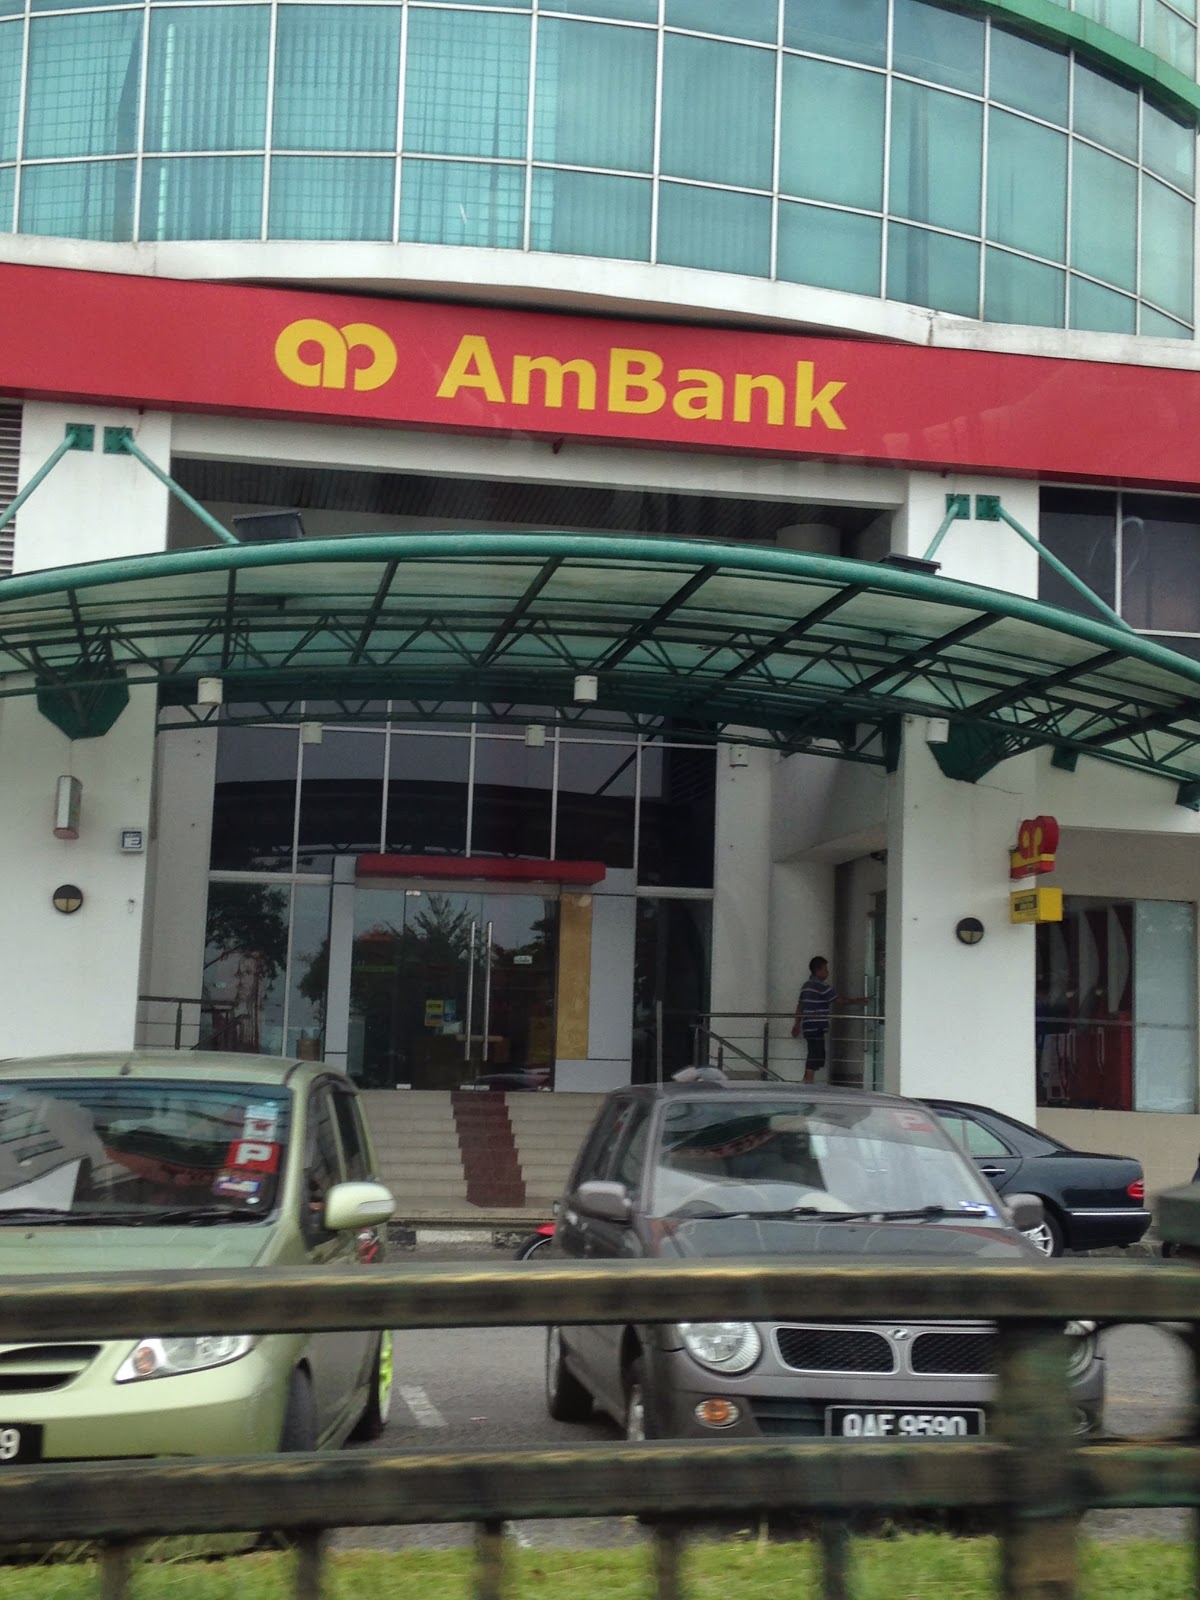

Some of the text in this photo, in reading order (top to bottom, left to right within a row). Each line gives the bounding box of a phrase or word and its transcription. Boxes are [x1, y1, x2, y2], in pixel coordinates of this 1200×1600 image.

[436, 334, 846, 430] AmBank
[235, 1142, 273, 1165] P
[0, 1428, 21, 1460] 9
